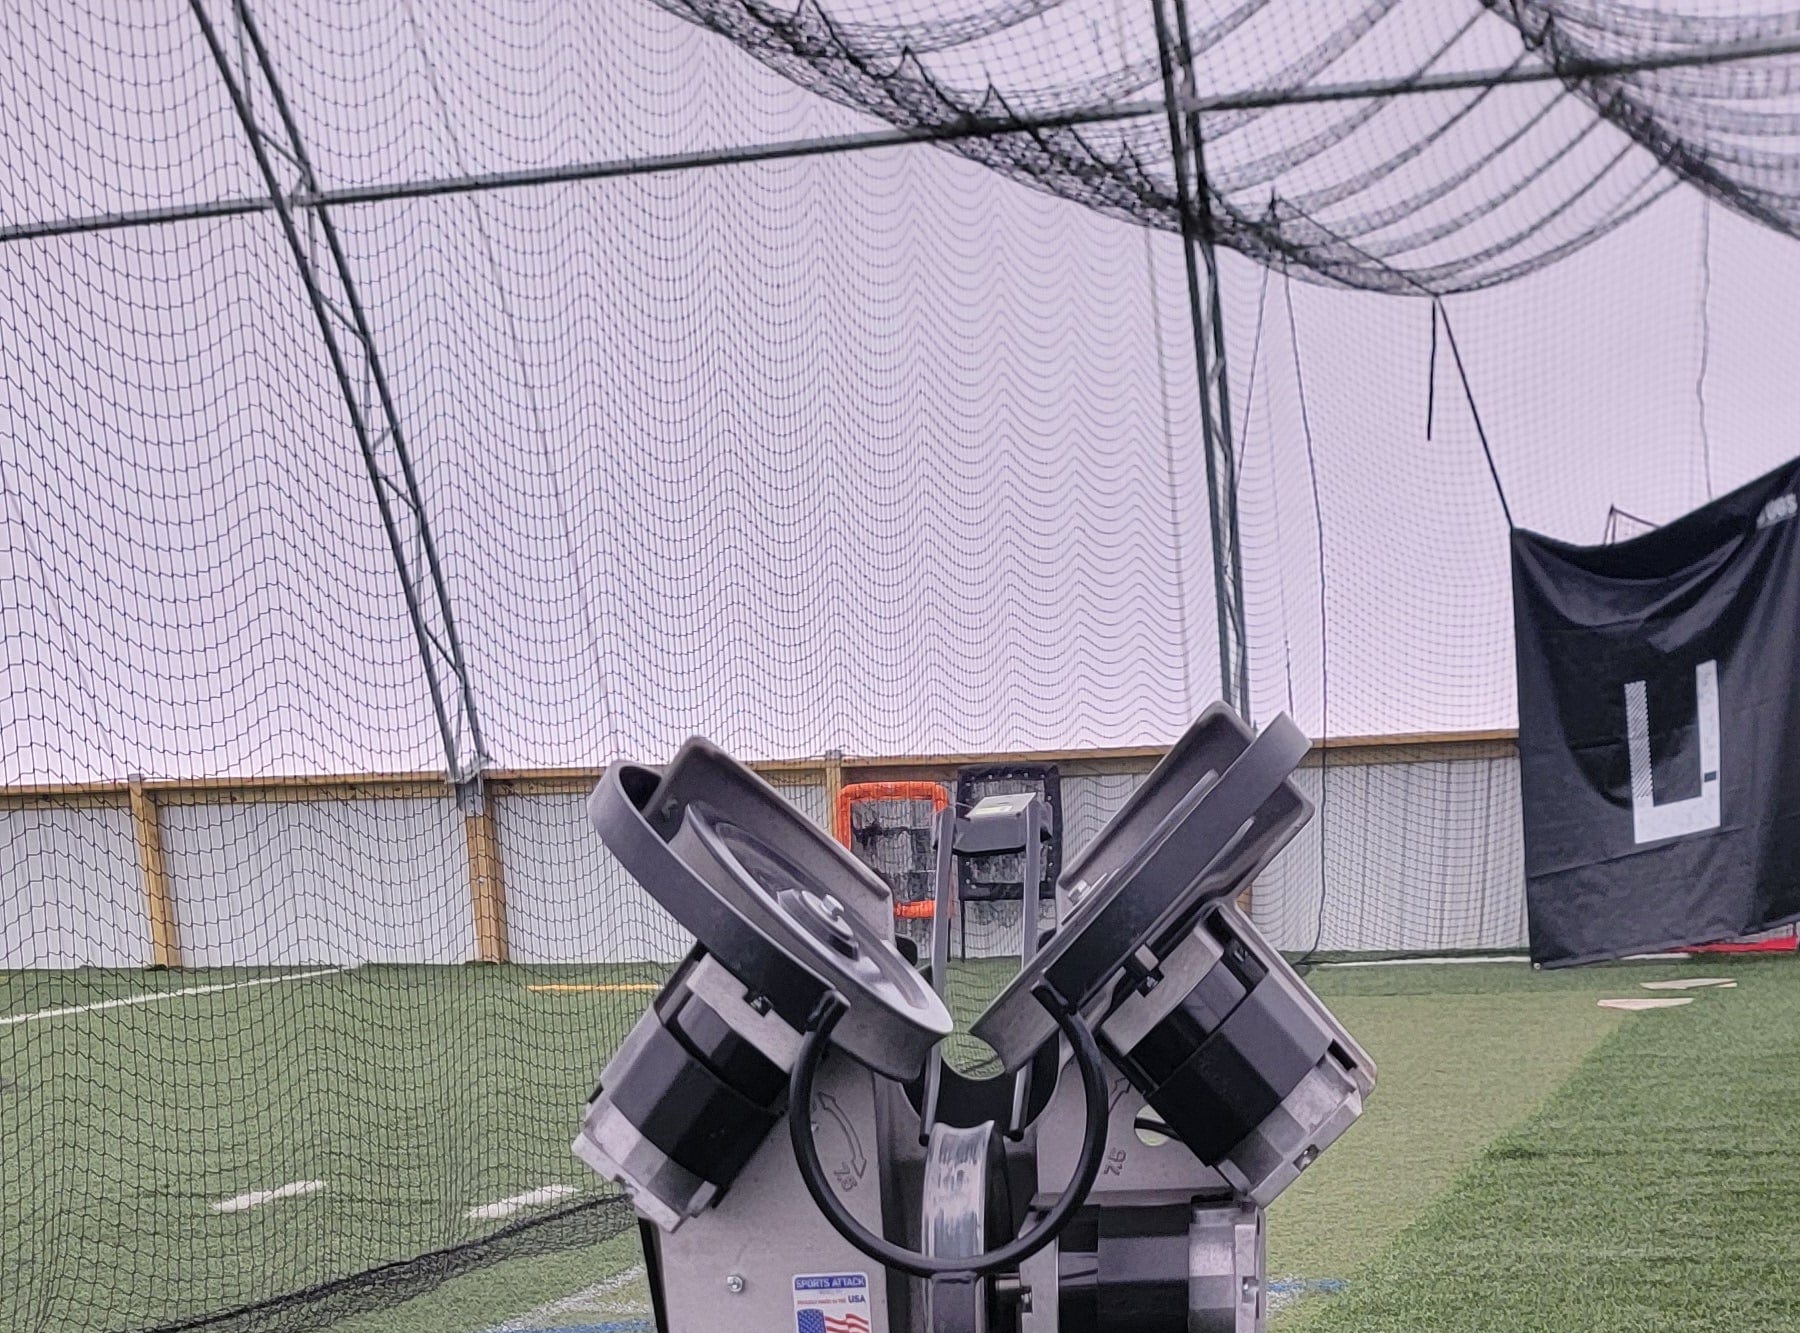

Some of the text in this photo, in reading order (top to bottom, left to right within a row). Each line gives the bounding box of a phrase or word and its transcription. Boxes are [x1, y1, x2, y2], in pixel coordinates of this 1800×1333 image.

[796, 1277, 865, 1288] SPORTS ATTACK
[848, 1295, 866, 1303] USA
